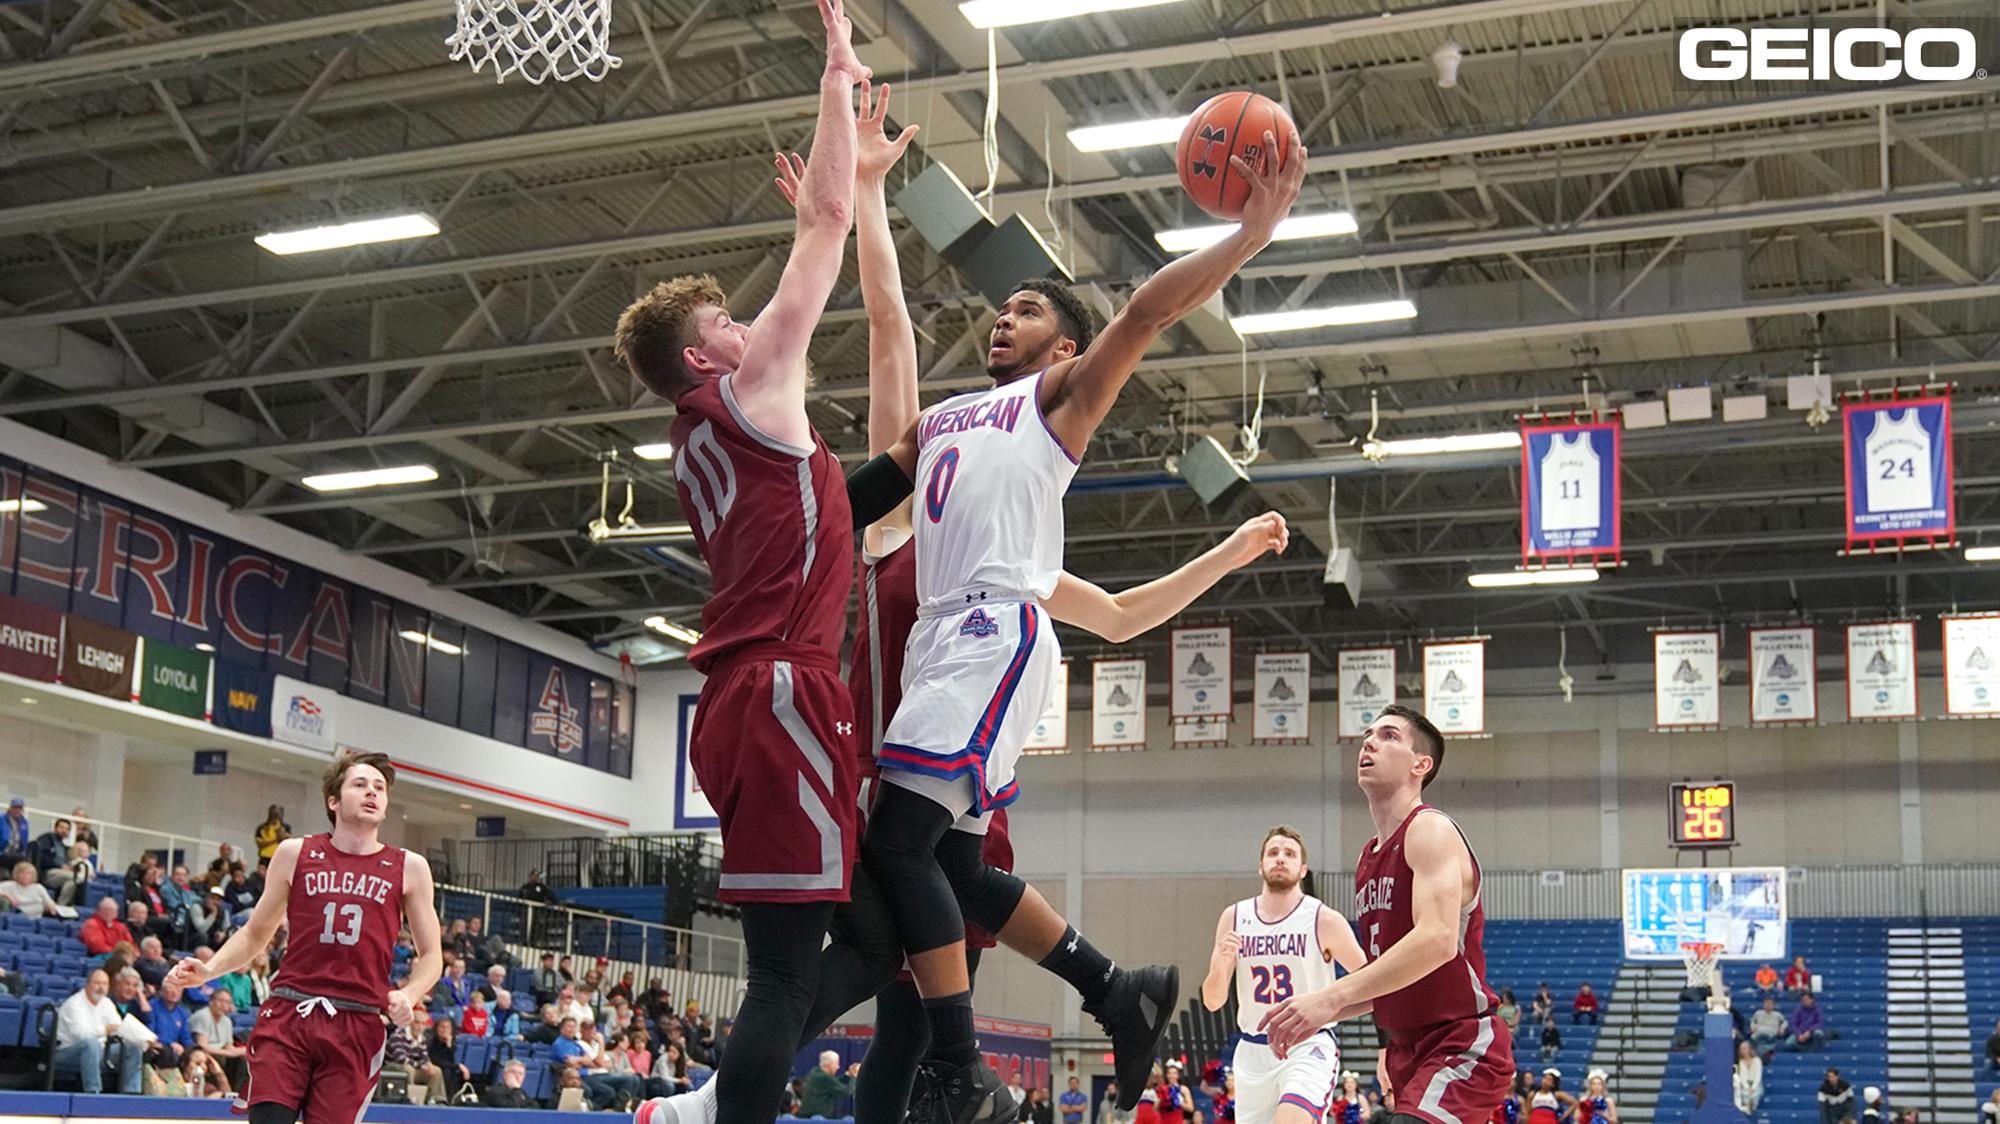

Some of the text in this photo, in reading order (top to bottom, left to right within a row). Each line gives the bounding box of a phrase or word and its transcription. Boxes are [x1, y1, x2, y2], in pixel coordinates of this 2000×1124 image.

[675, 418, 737, 542] 10
[1880, 458, 1915, 479] 24
[926, 446, 960, 524] 0
[1560, 480, 1582, 499] 11
[77, 643, 125, 674] LEHIGH
[153, 664, 198, 693] LOYOLA
[228, 689, 257, 711] NAVY
[1684, 807, 1724, 839] 26
[305, 871, 393, 905] COLGATE
[319, 902, 363, 946] 13
[1239, 934, 1307, 958] AMERICAN
[1250, 963, 1294, 1005] 23
